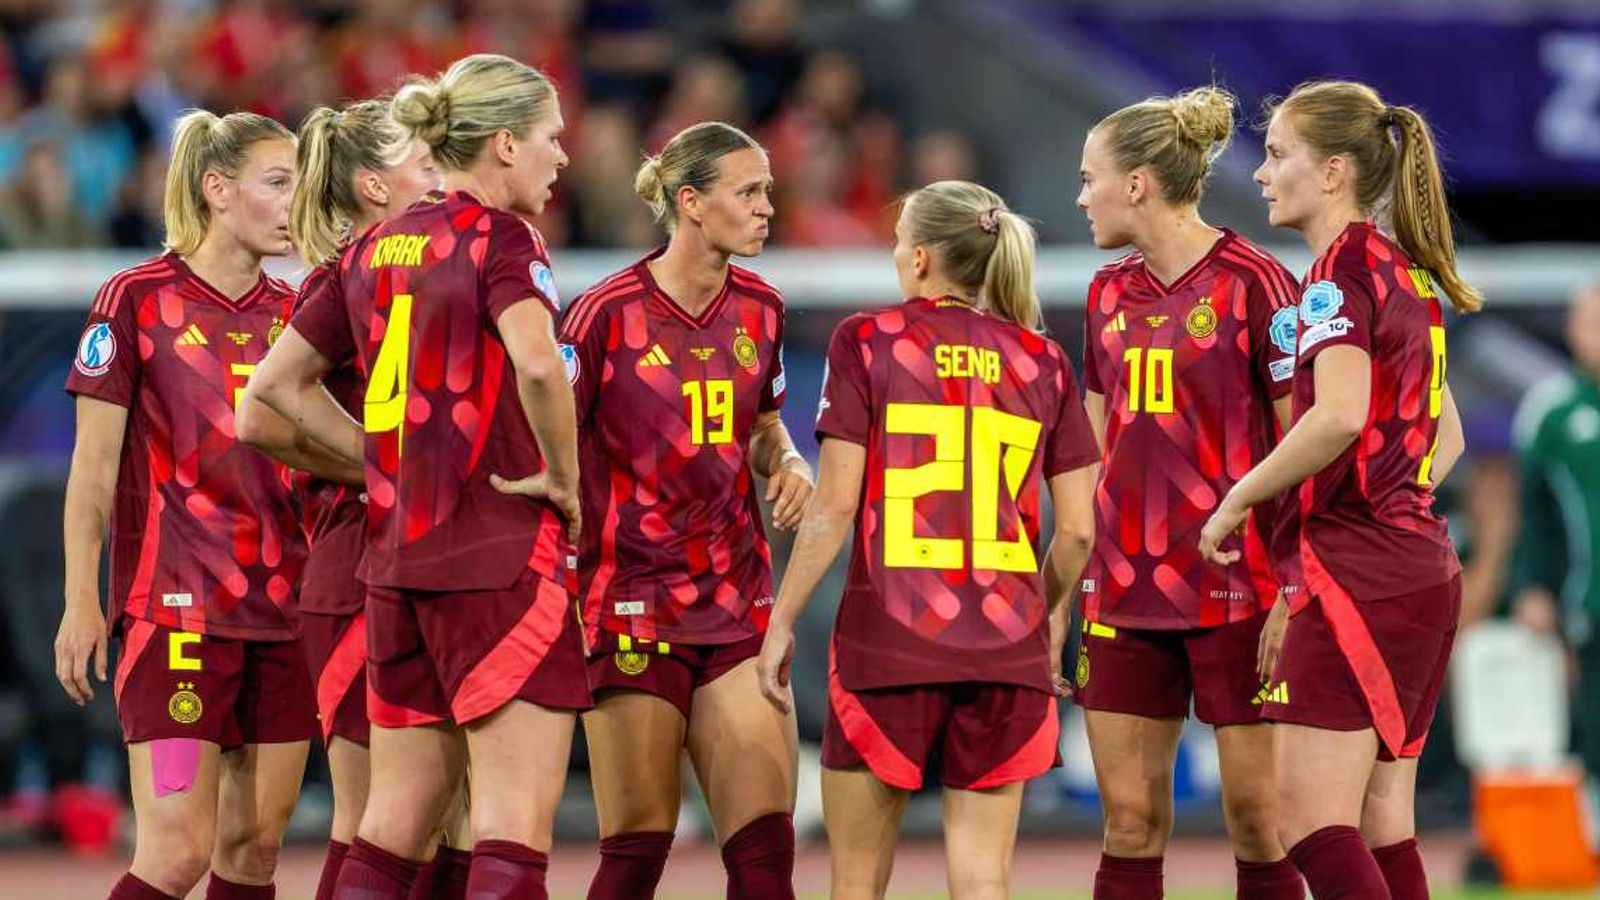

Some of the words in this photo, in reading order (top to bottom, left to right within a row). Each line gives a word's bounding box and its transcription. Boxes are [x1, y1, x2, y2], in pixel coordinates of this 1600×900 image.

[369, 234, 431, 269] KNAAK
[363, 294, 413, 460] 4
[934, 344, 1001, 385] SENA
[1123, 347, 1174, 414] 10
[682, 379, 734, 445] 19
[883, 402, 1043, 574] 20
